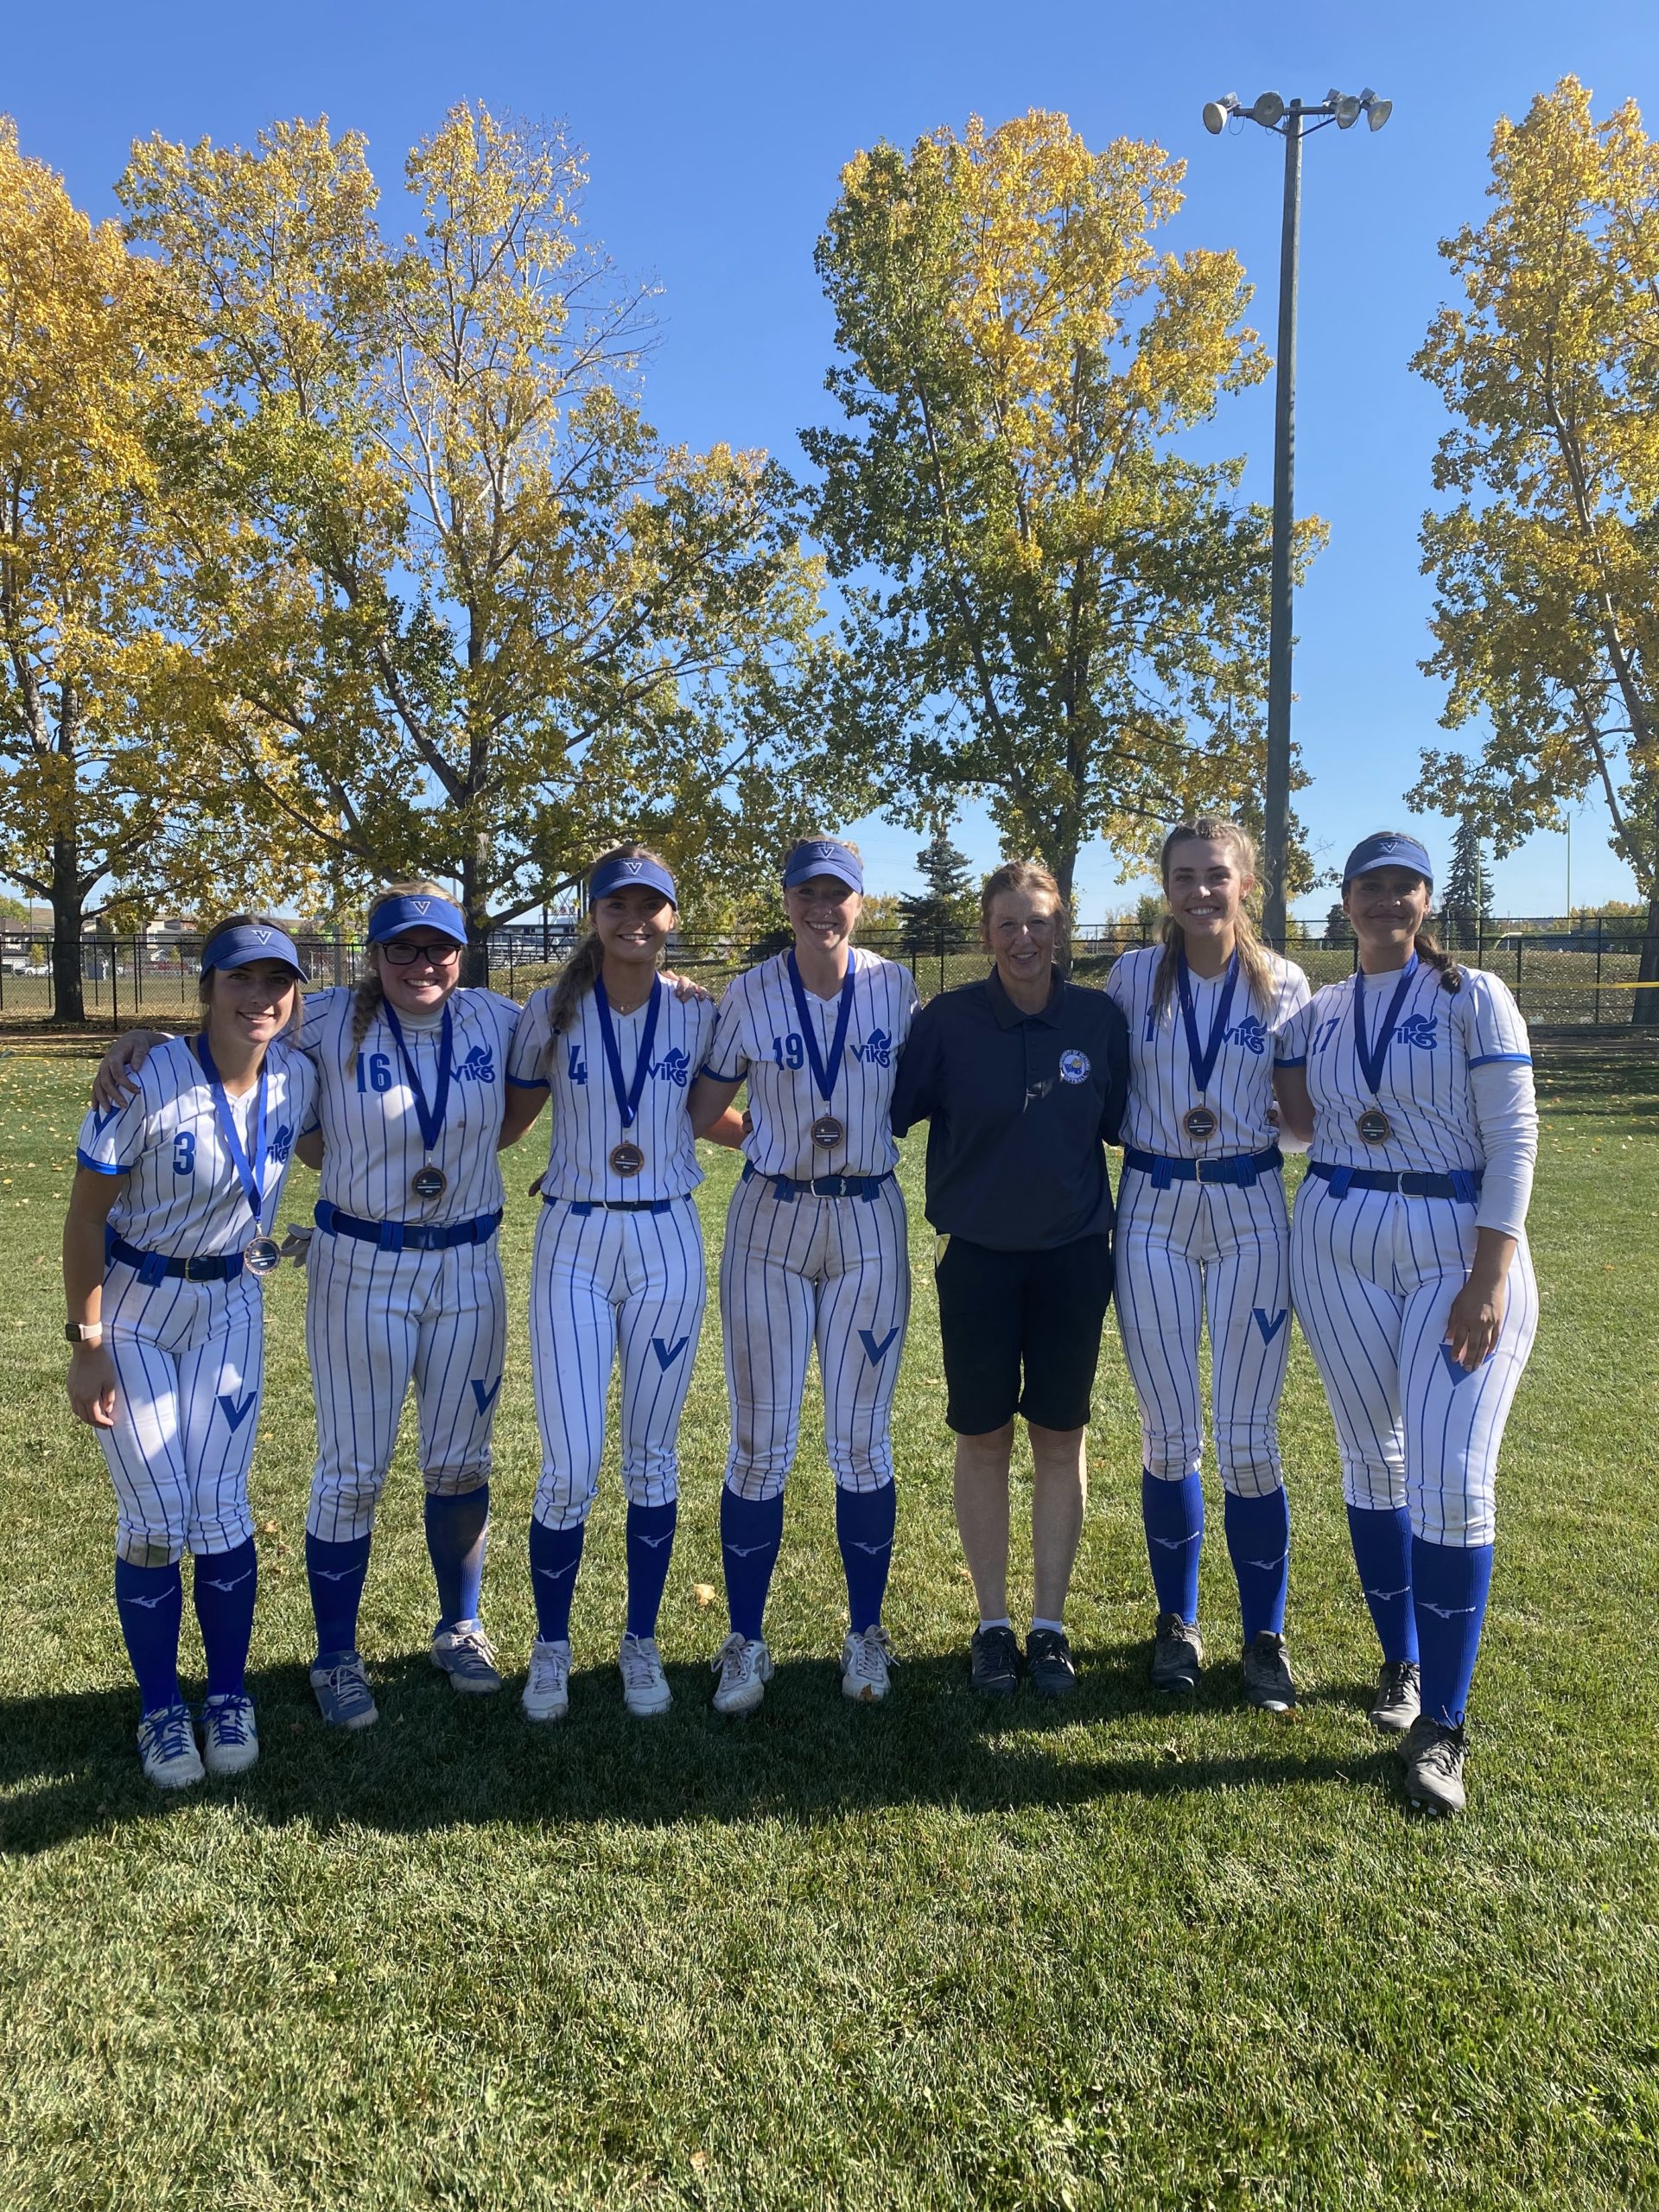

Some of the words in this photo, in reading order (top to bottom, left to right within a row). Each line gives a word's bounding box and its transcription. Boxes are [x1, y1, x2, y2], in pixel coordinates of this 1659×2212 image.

[818, 846, 835, 859] V
[1379, 842, 1398, 854] V
[624, 861, 643, 875] V
[409, 900, 430, 916] V
[251, 930, 271, 945] V
[772, 1033, 804, 1071] 19
[1312, 1017, 1340, 1056] 17
[356, 1052, 392, 1093] 16
[568, 1046, 588, 1085] 4
[173, 1131, 196, 1175] 3
[1252, 1308, 1288, 1346] V
[651, 1336, 690, 1373] V
[858, 1327, 899, 1368] V
[217, 1391, 257, 1434] V
[470, 1375, 503, 1417] V
